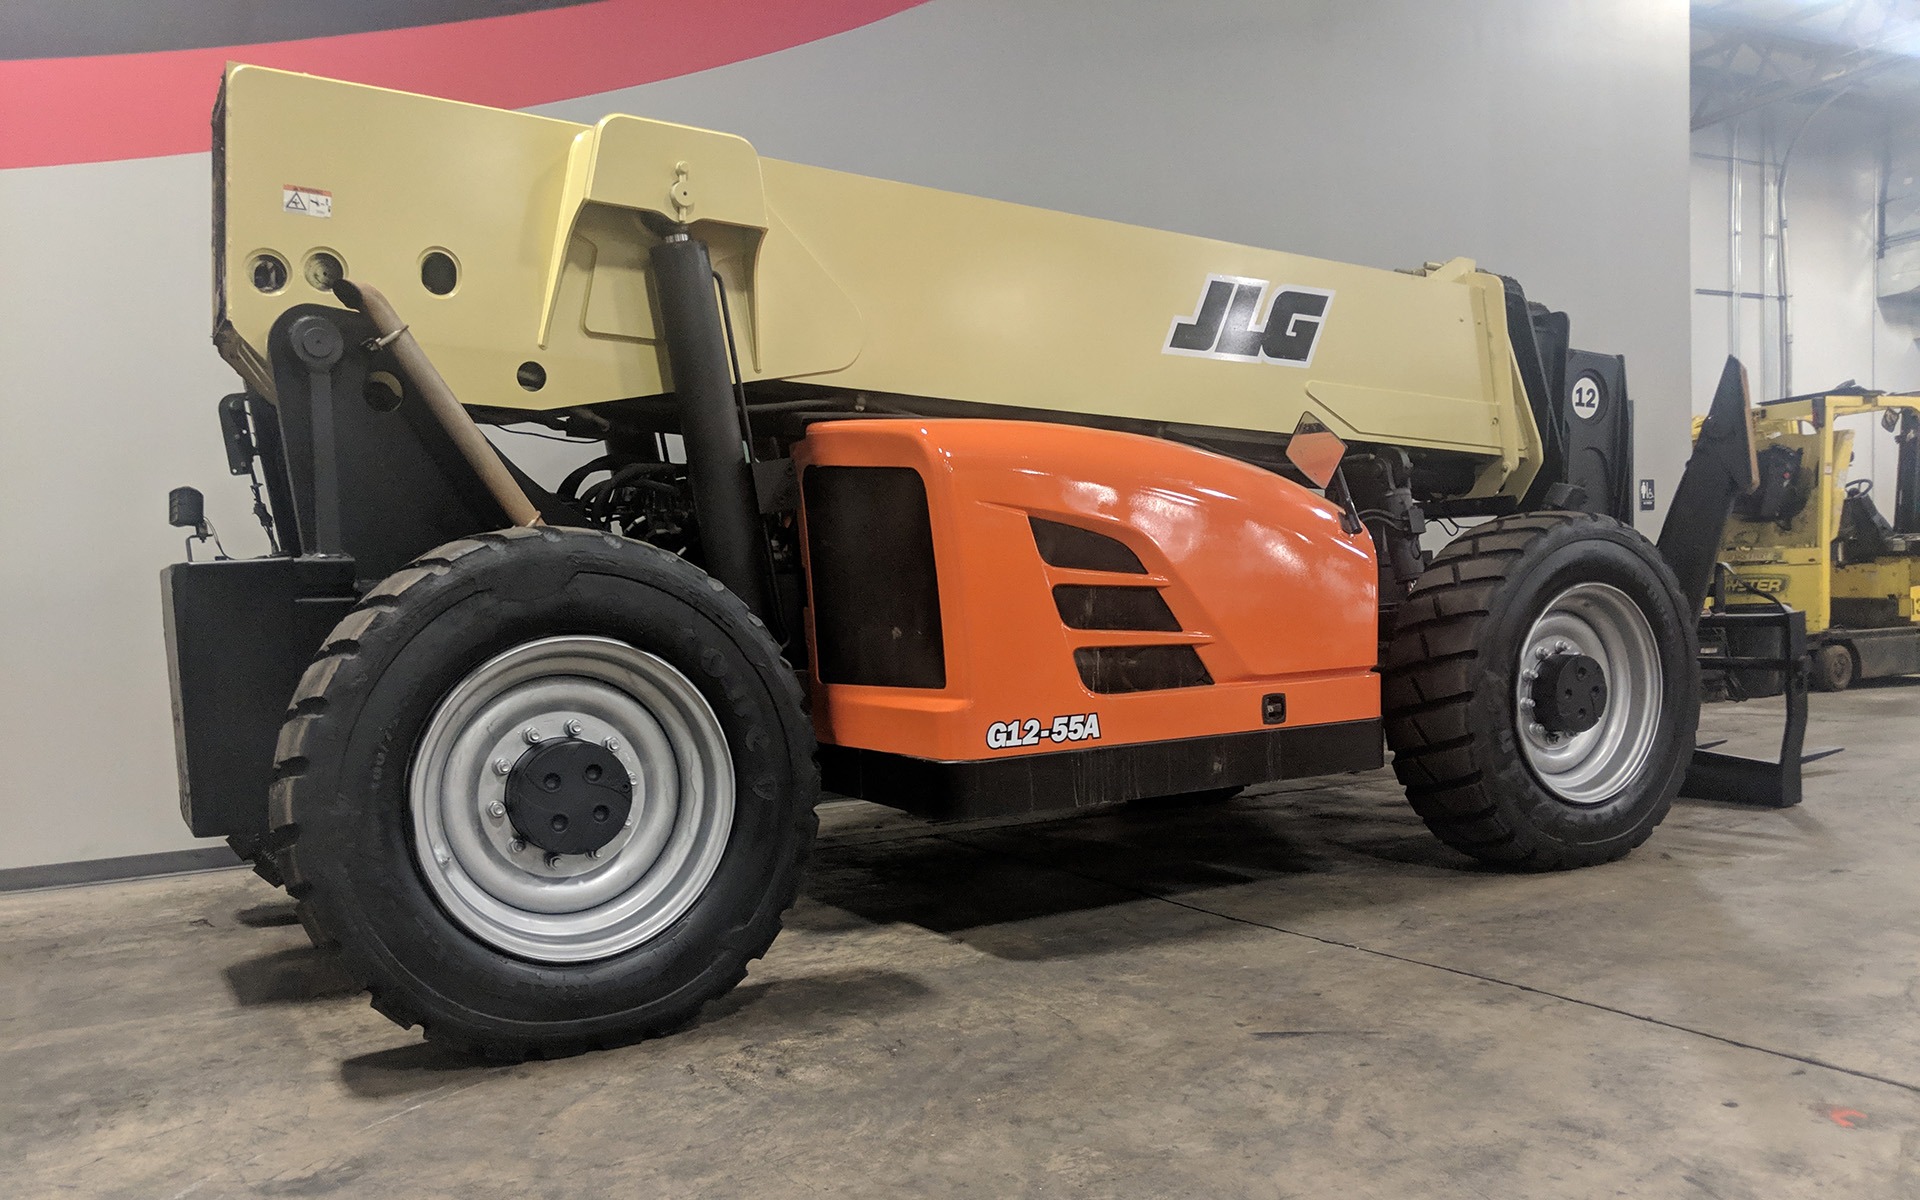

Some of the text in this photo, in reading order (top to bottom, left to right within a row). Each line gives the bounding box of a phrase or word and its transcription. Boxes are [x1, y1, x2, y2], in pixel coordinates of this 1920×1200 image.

[1165, 276, 1333, 365] JLG
[1574, 386, 1596, 408] 12
[986, 713, 1101, 749] G12-55A
